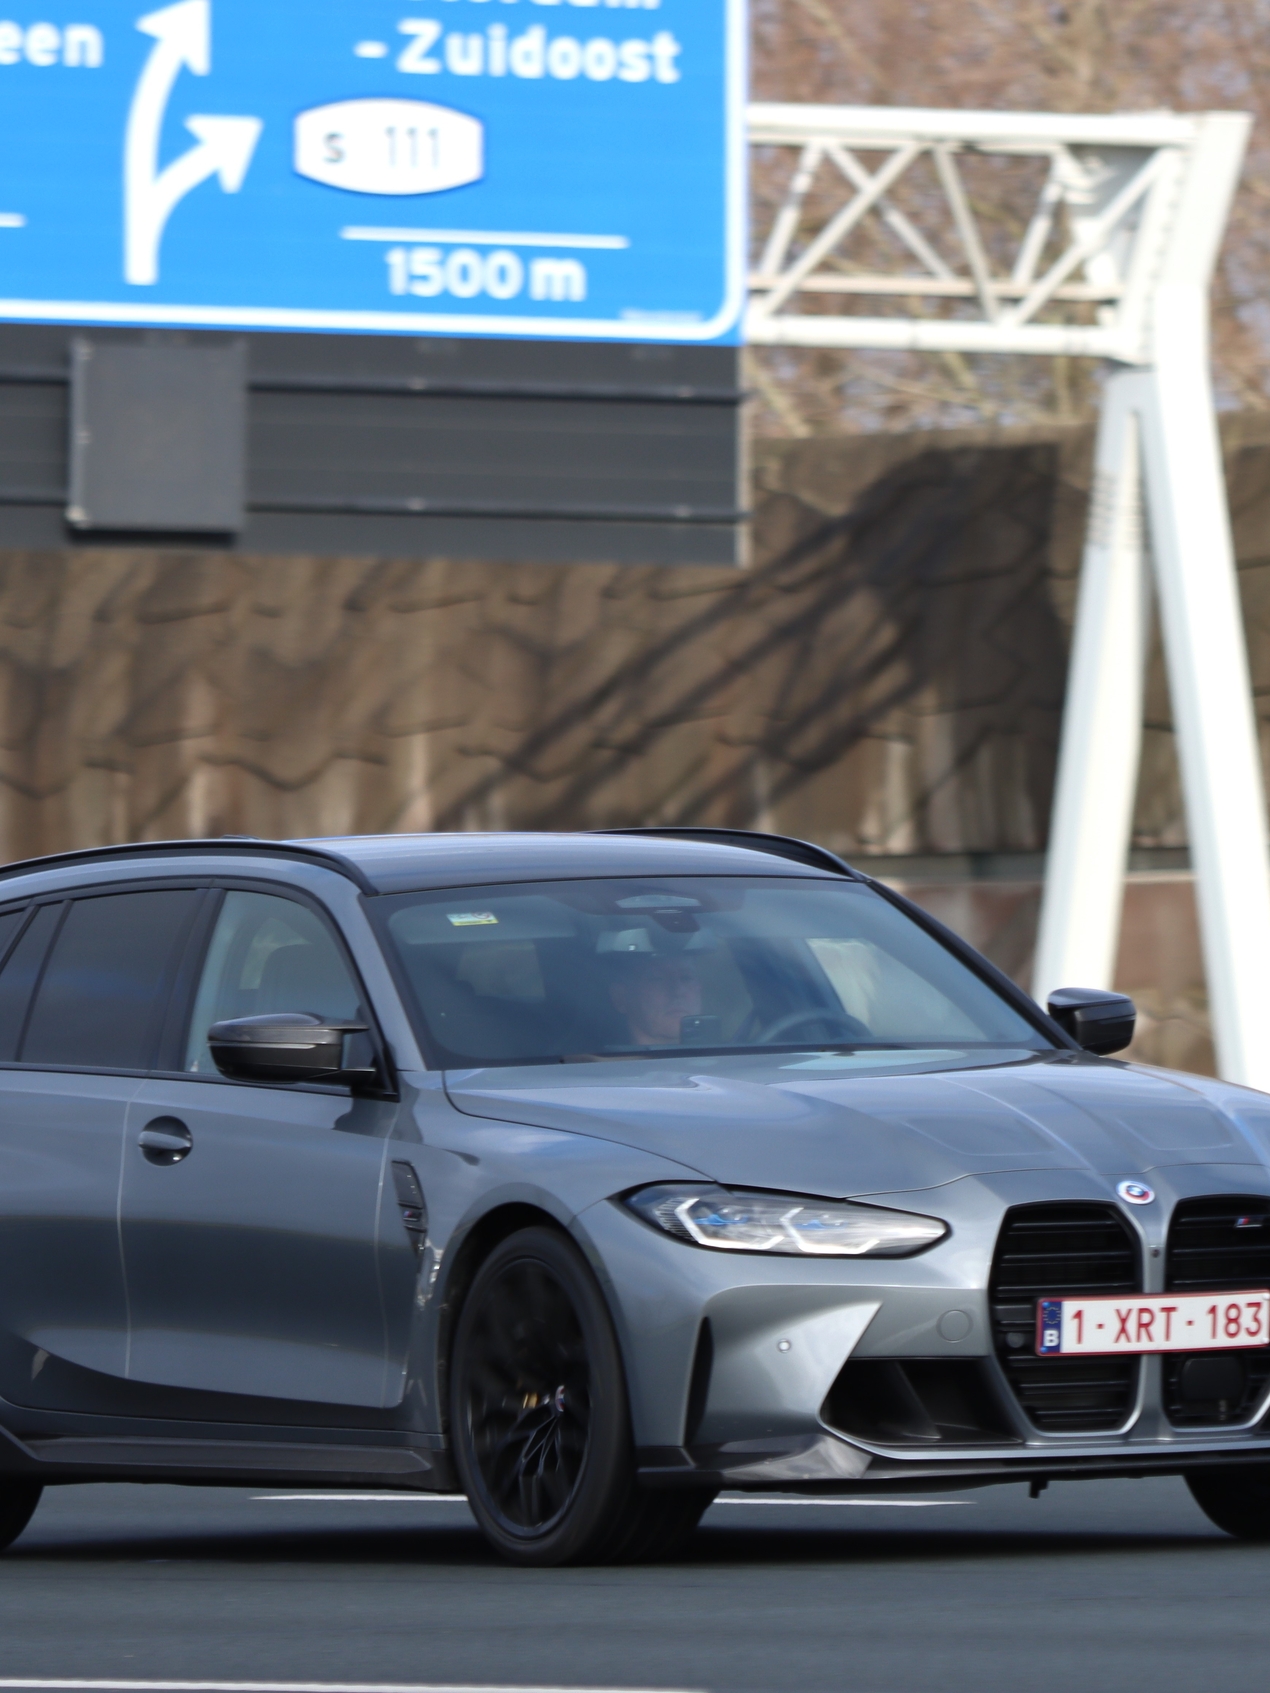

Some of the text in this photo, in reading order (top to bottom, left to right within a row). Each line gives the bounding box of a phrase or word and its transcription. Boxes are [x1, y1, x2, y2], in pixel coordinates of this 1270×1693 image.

[323, 126, 439, 168] S 111
[385, 246, 587, 302] 1500 m
[1044, 1330, 1059, 1347] B
